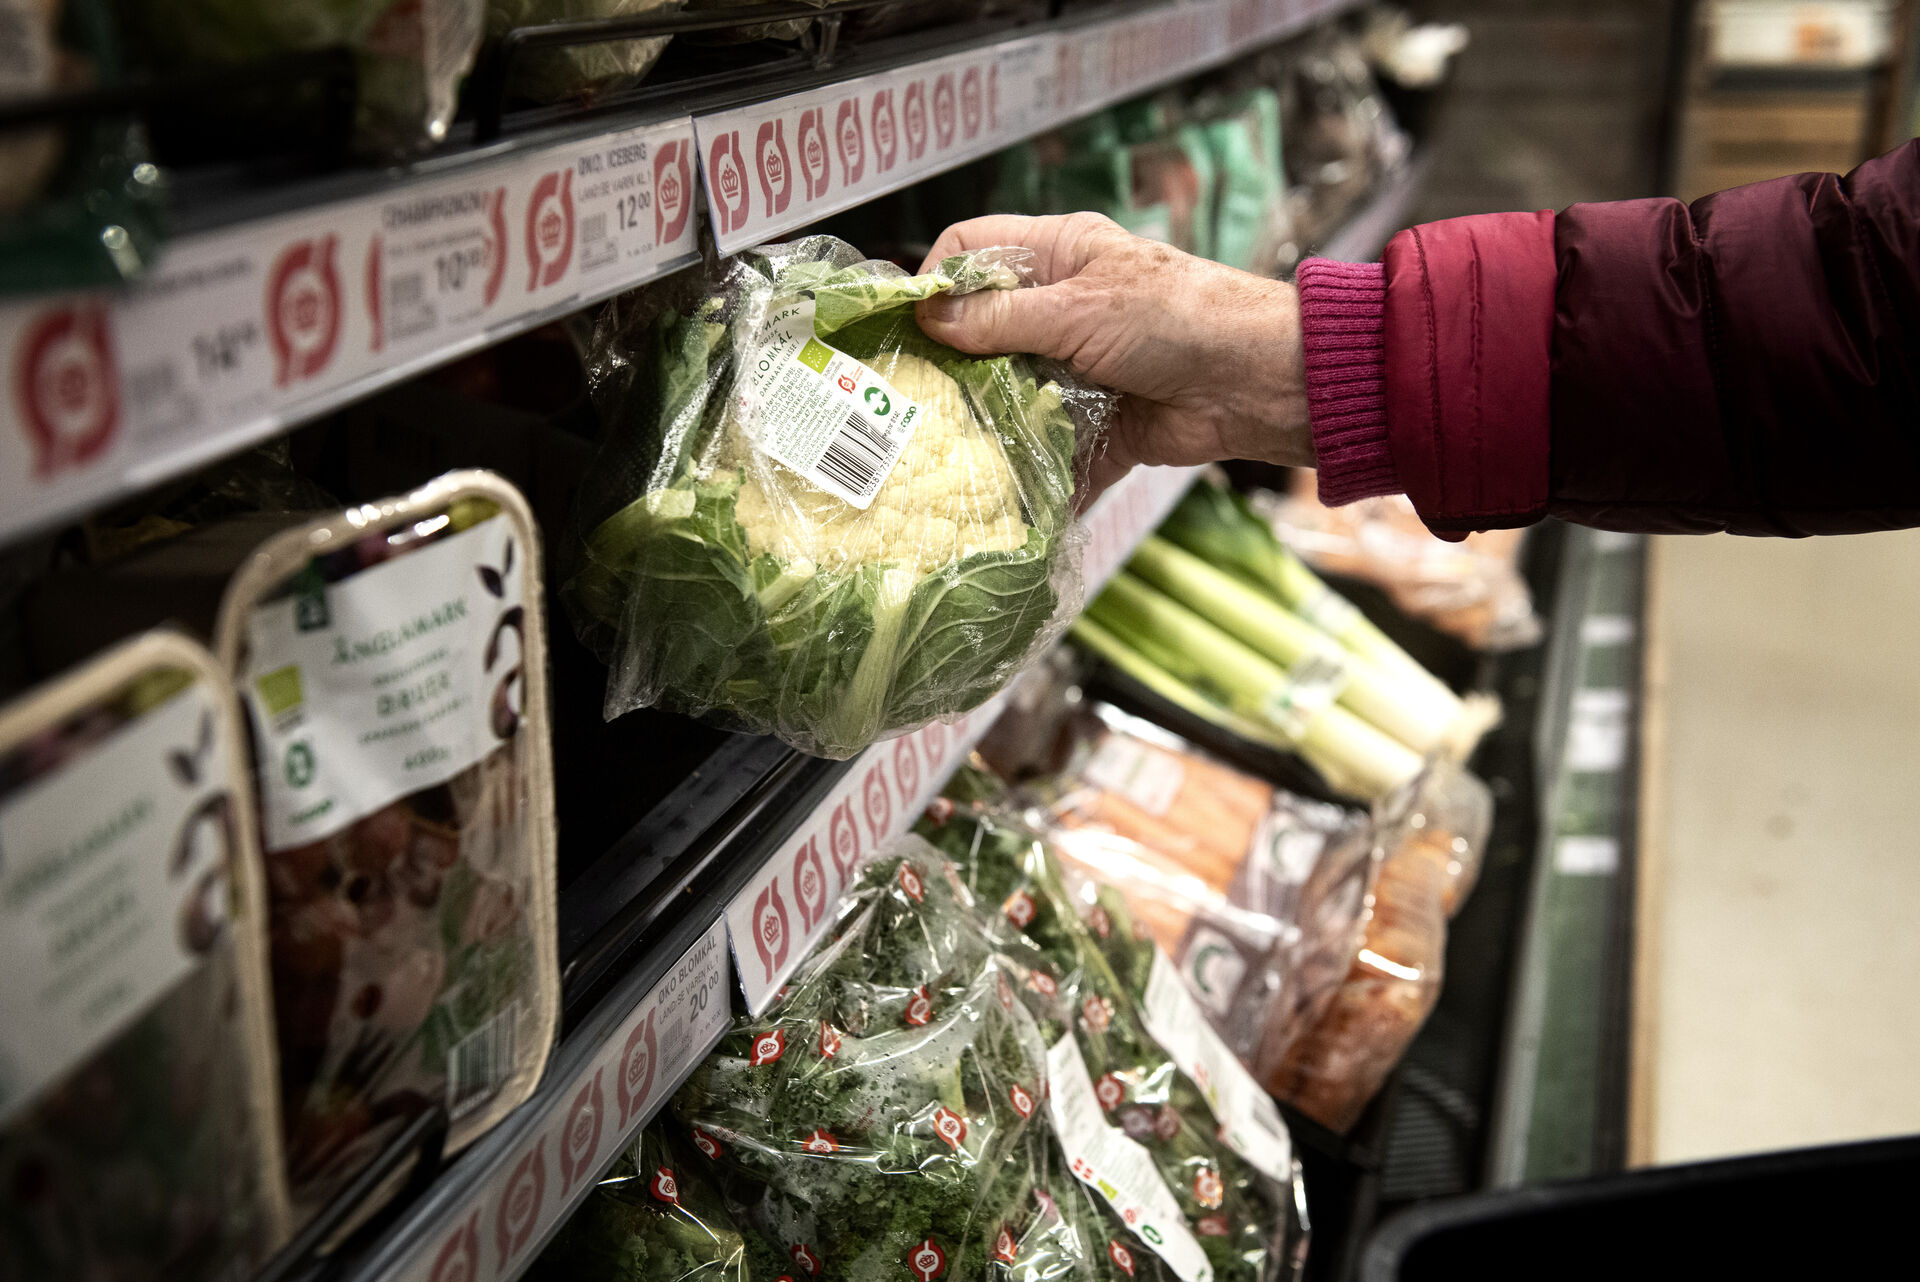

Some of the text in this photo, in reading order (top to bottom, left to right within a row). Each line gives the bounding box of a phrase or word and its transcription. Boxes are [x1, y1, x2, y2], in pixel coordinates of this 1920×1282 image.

[607, 142, 647, 168] ICEBERG
[760, 362, 786, 398] DANMARK
[658, 977, 677, 1005] ØKO
[678, 933, 717, 985] BLOMKÅL
